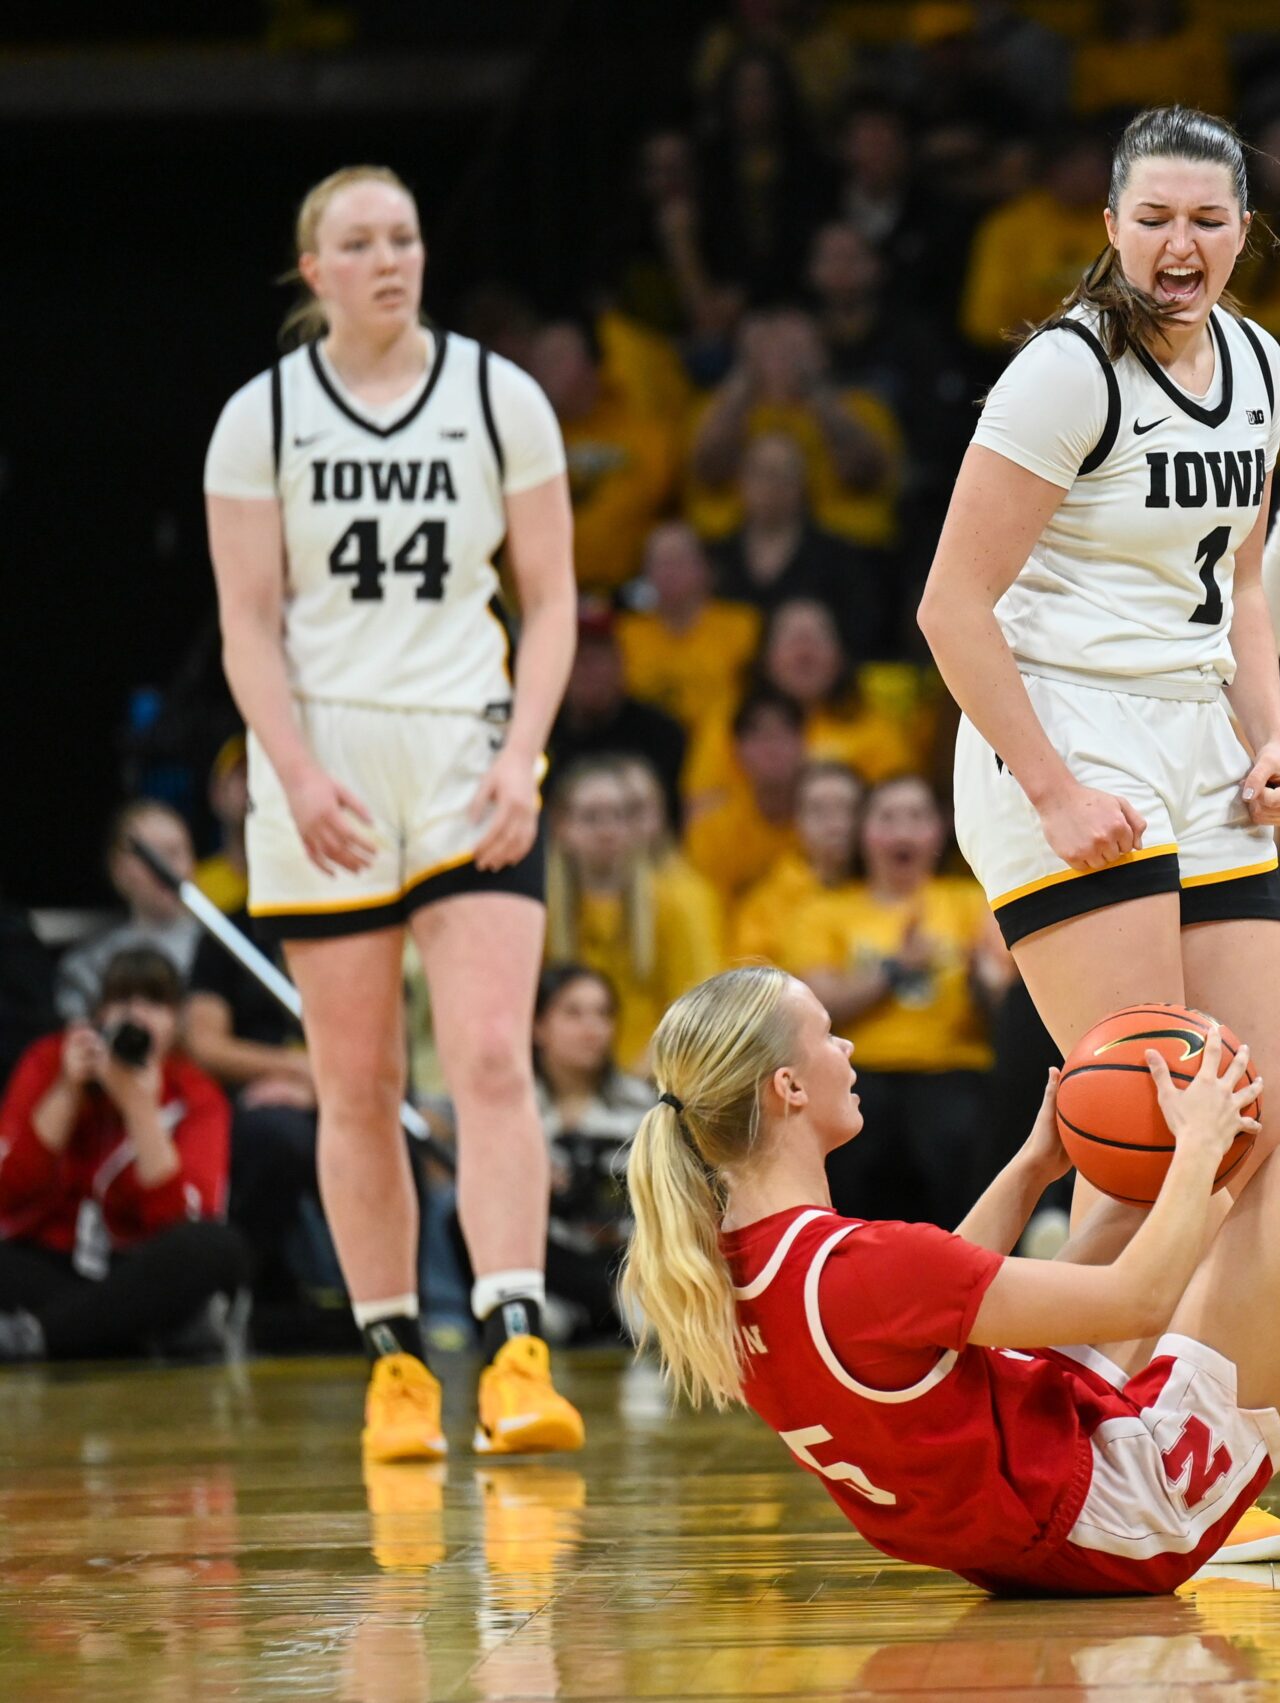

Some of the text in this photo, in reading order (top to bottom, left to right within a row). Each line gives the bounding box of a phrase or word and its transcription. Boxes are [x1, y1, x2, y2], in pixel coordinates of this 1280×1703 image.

[311, 459, 458, 504] IOWA
[328, 518, 451, 603] 44
[1188, 526, 1232, 625] 1
[1160, 1413, 1233, 1511] N
